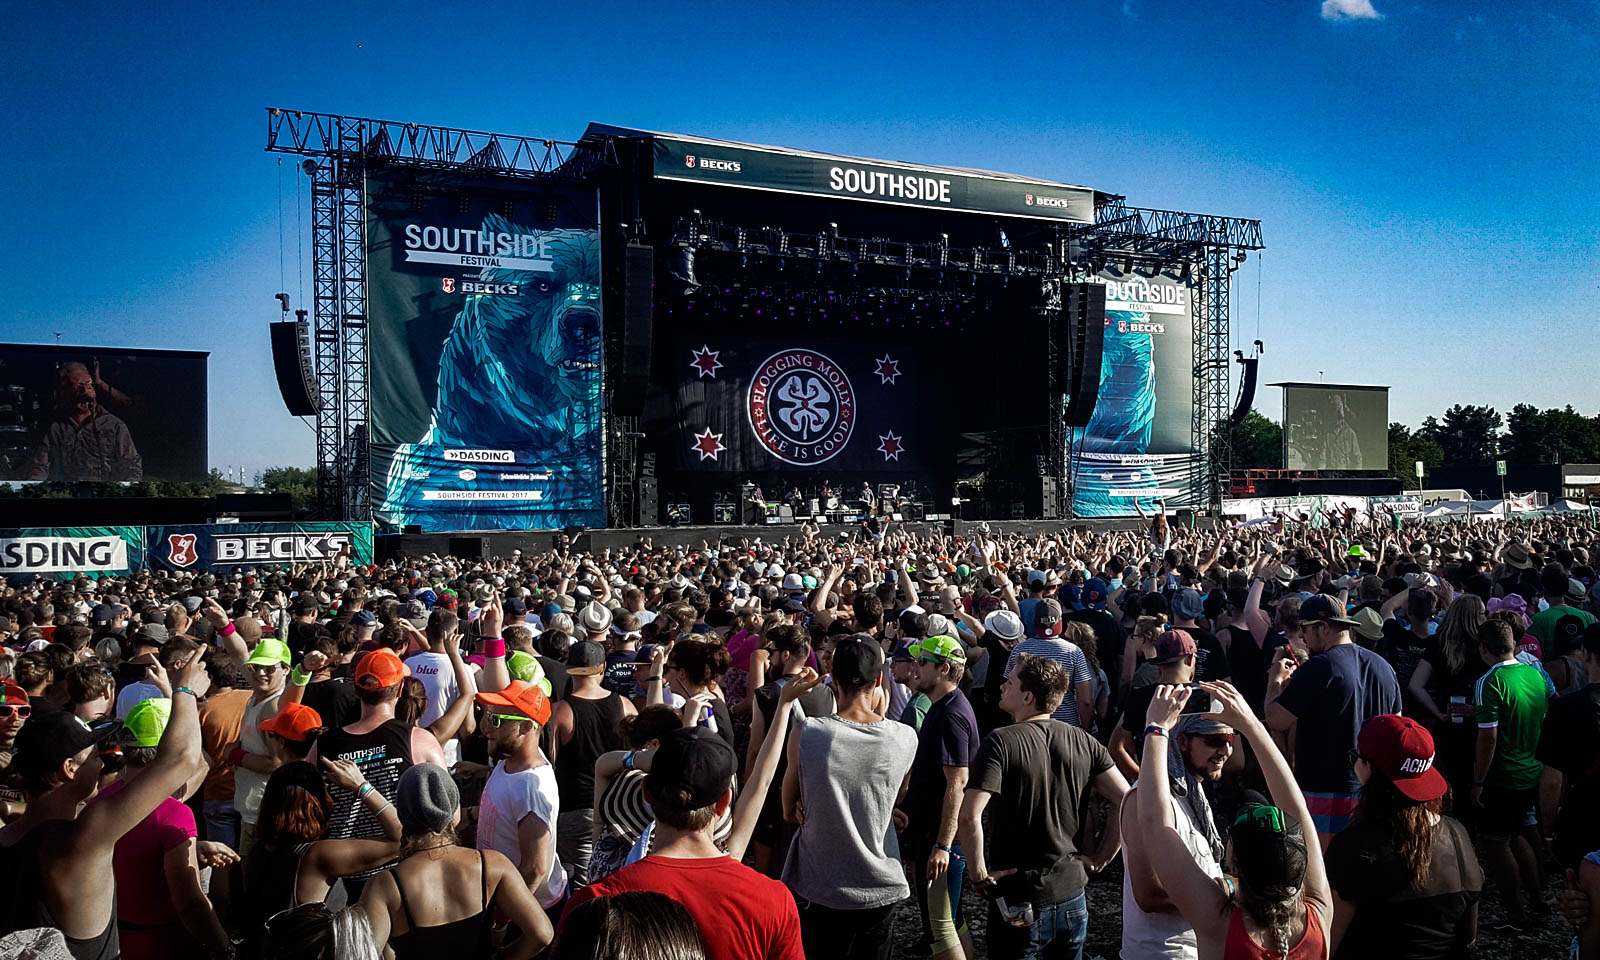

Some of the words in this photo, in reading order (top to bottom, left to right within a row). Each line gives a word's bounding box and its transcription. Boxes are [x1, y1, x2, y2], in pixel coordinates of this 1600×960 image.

[700, 158, 741, 172] BECK'S
[829, 166, 951, 203] SOUTHSIDE
[404, 223, 553, 259] SOUTHSIDE
[460, 255, 502, 267] FESTIVAL
[461, 281, 518, 295] BECK'S
[1105, 279, 1185, 305] OUTHSIDE
[1130, 323, 1165, 333] BECK'S
[753, 354, 813, 405] FLOGGING
[817, 361, 851, 408] MOLLY
[757, 419, 789, 453] LIFE
[794, 446, 808, 459] IS
[814, 420, 849, 457] GOOD
[459, 451, 510, 462] DASDING
[0, 541, 112, 568] SDING
[216, 533, 349, 561] BECK'S
[416, 664, 439, 676] blue
[338, 745, 387, 761] SOUTHSIDE
